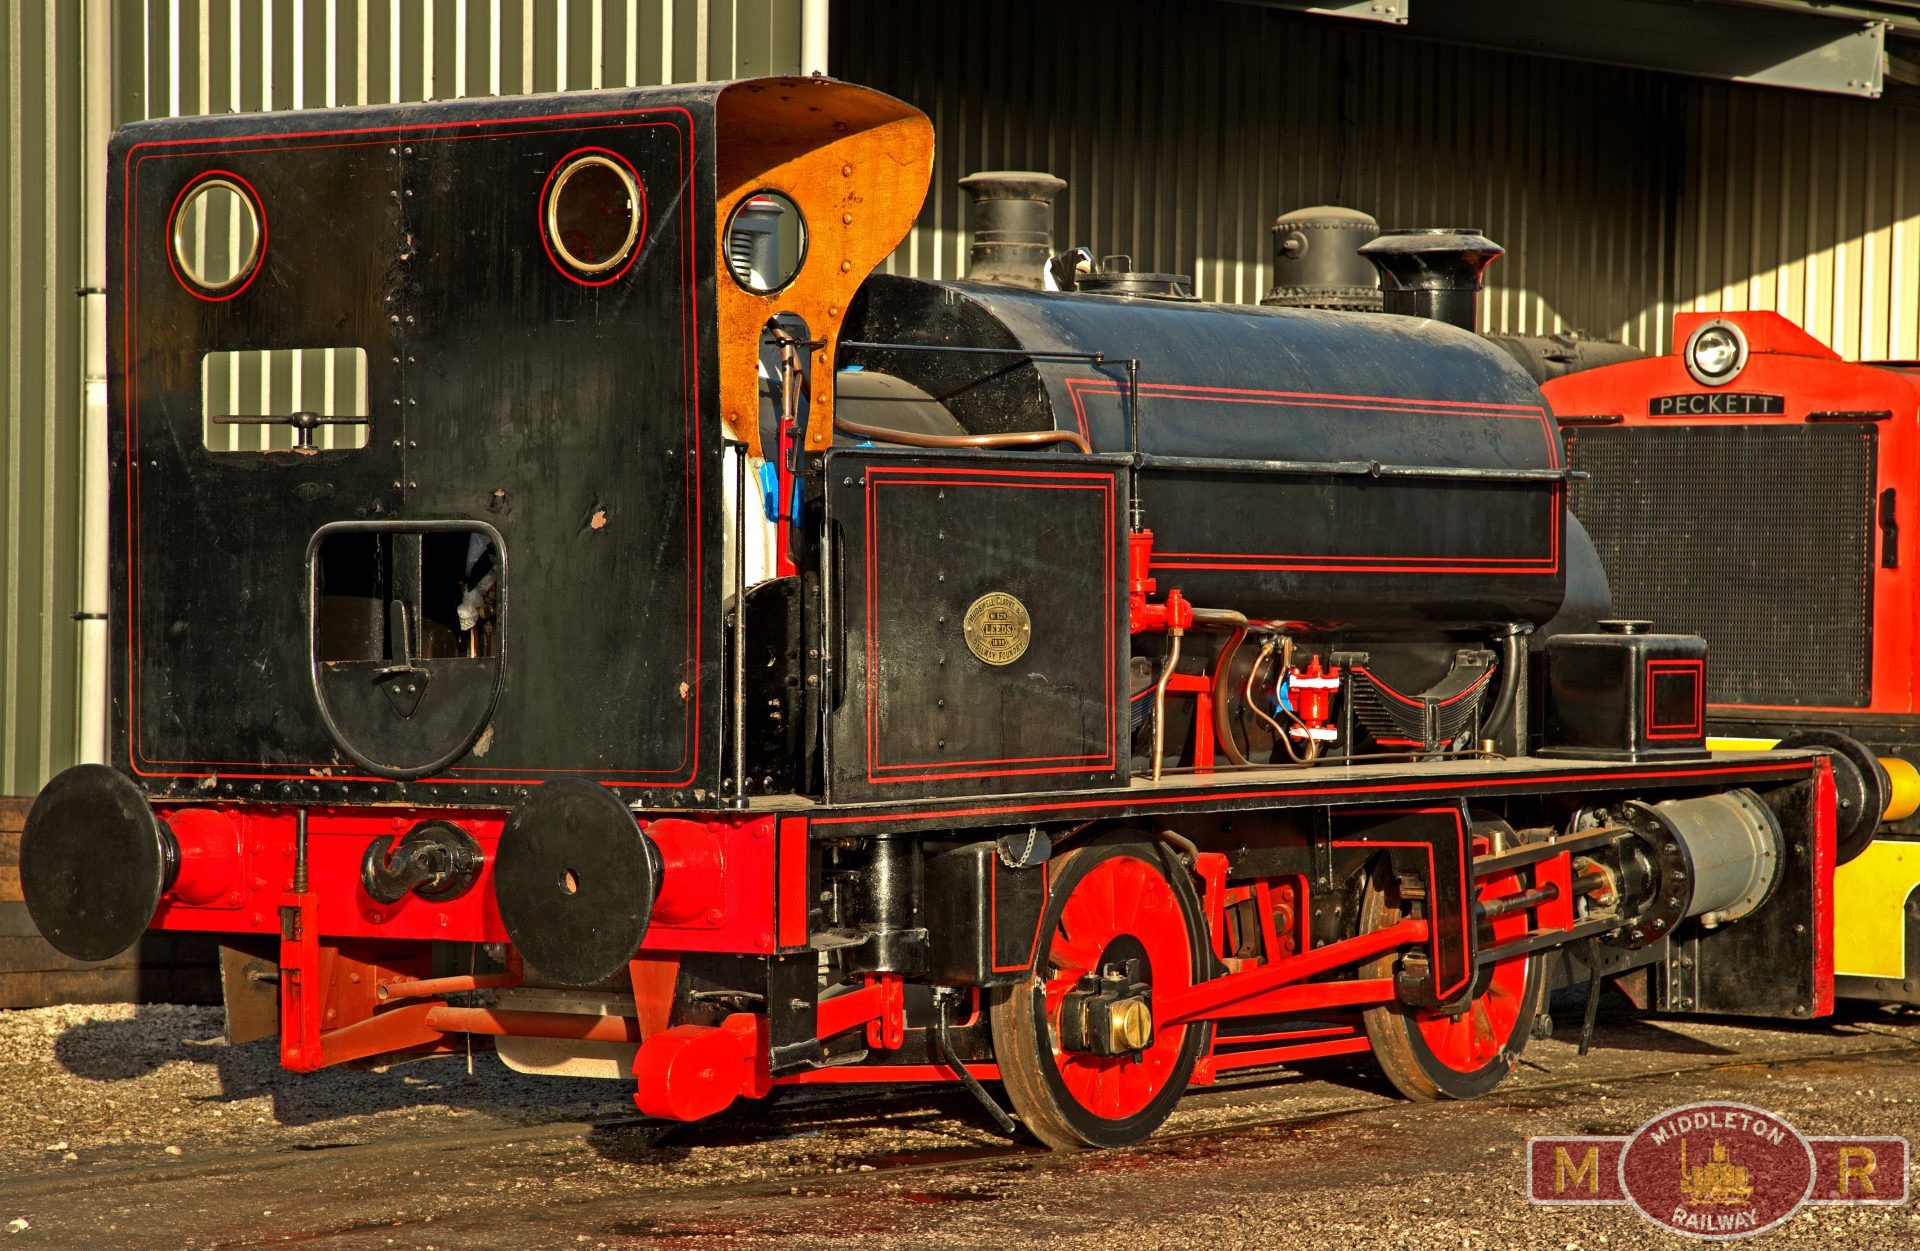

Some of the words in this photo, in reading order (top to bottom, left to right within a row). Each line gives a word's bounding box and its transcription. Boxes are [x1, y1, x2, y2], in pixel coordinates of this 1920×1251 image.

[1660, 394, 1773, 414] PECKETT
[968, 598, 994, 623] HUDSWELL
[996, 596, 1016, 609] CLARKE
[985, 624, 1012, 635] LEEDS
[971, 639, 996, 660] RAILWAY
